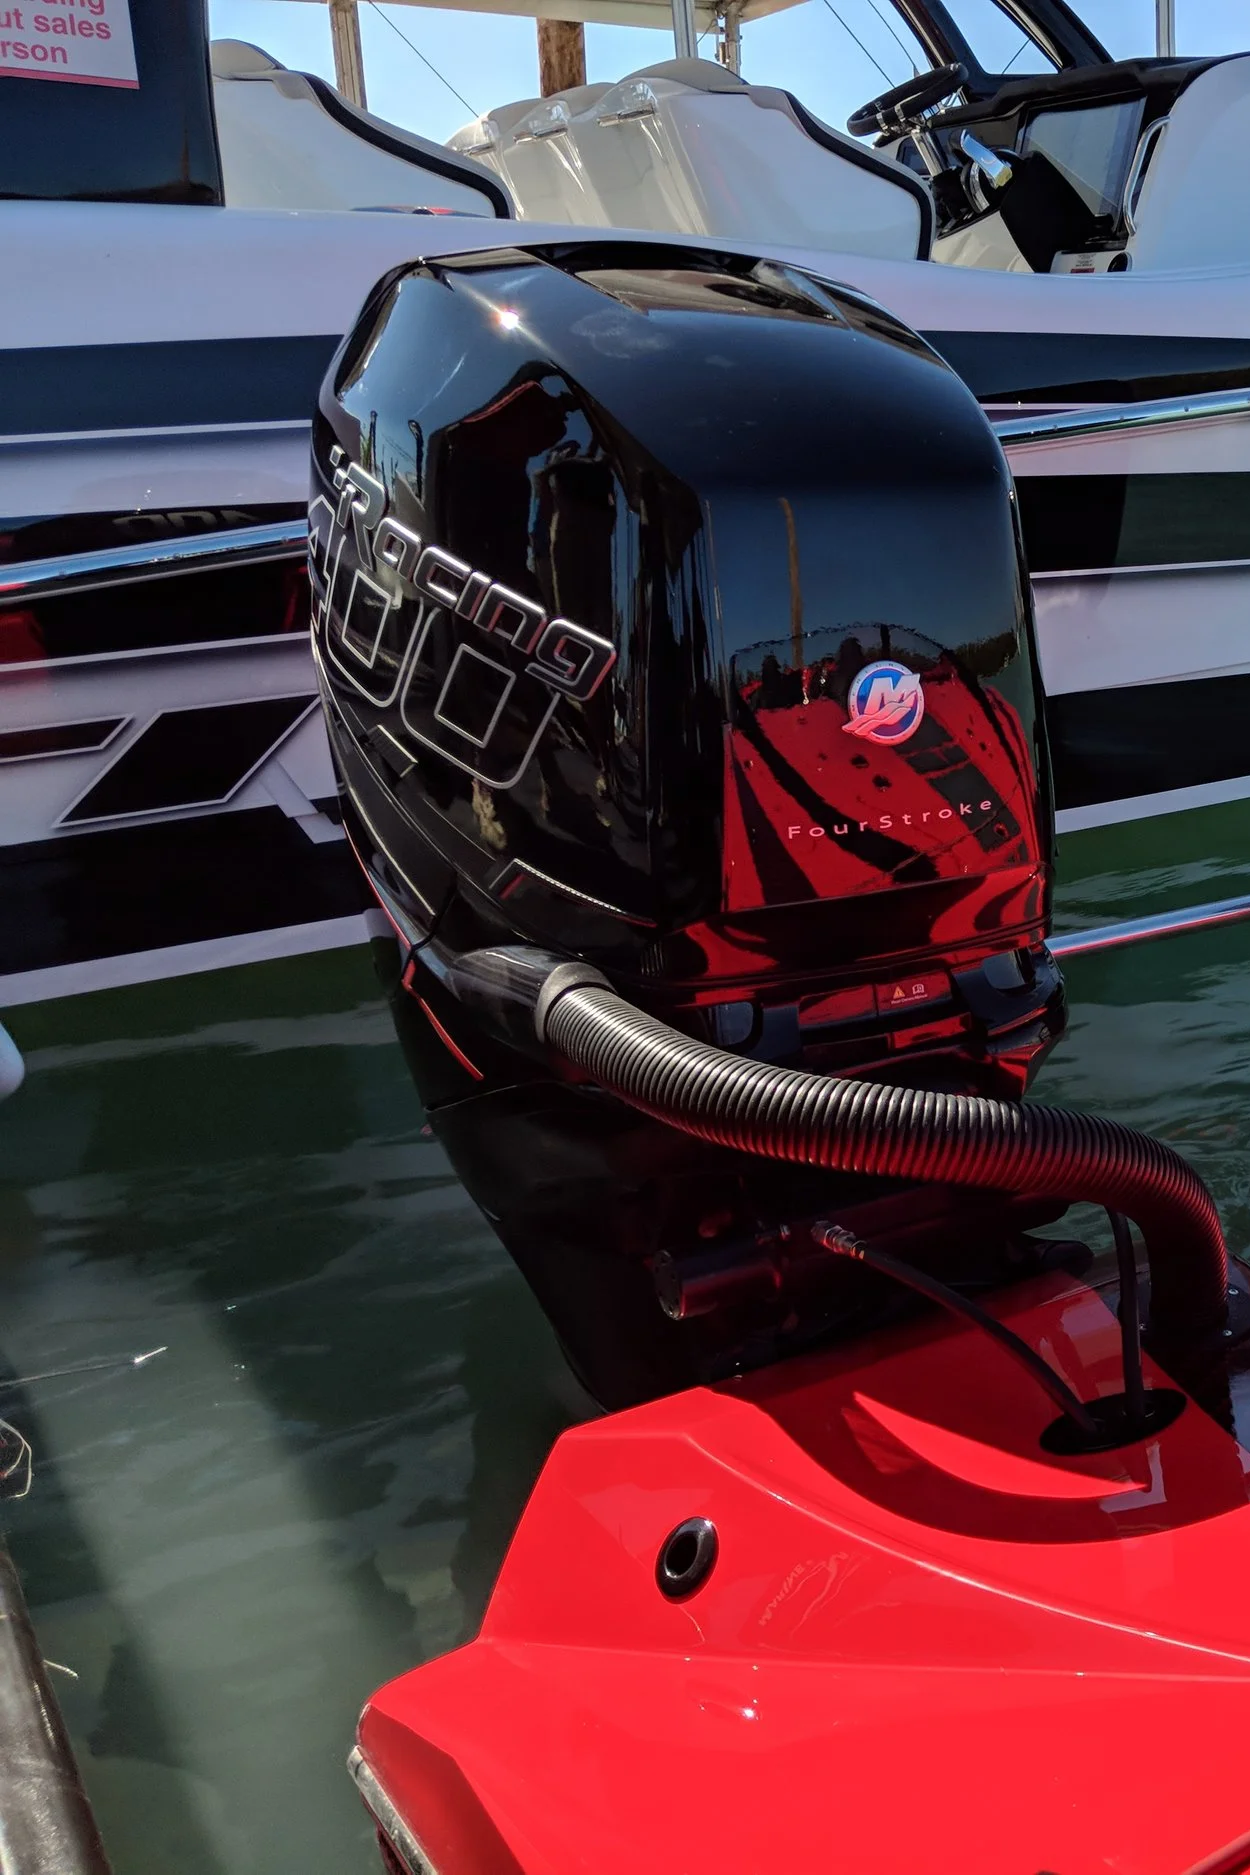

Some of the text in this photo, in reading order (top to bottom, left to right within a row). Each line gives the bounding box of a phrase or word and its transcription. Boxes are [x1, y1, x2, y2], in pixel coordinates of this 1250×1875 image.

[33, 13, 111, 40] sales
[0, 40, 68, 64] rson
[336, 461, 617, 700] Racing
[787, 798, 993, 840] FourStroke
